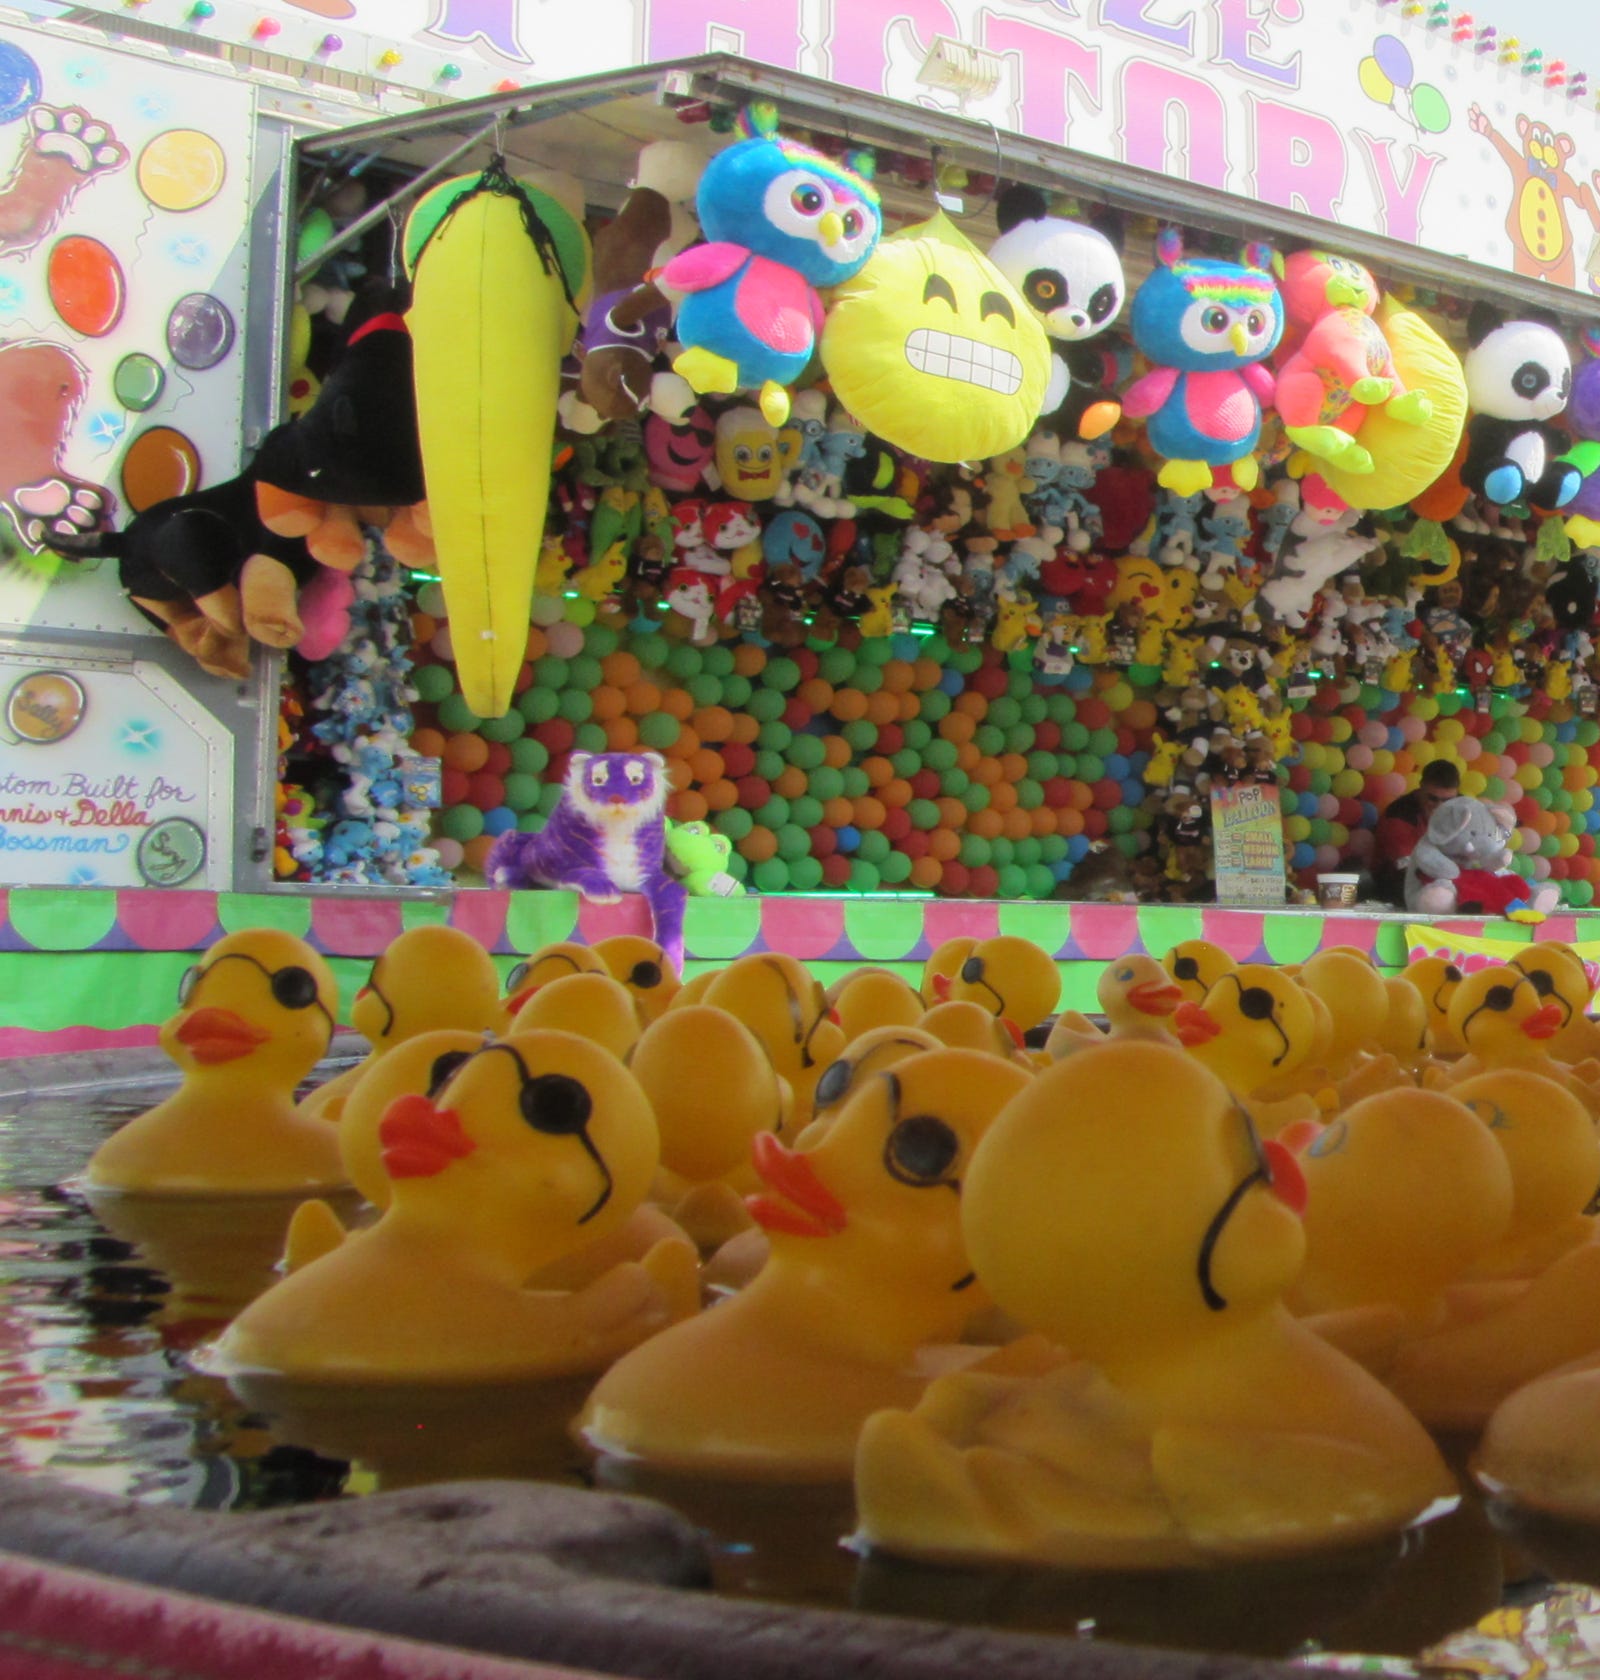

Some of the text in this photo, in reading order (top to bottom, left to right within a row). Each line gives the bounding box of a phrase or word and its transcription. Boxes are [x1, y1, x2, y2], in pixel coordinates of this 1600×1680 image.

[0, 772, 197, 809] tom Built for
[70, 798, 154, 827] Della
